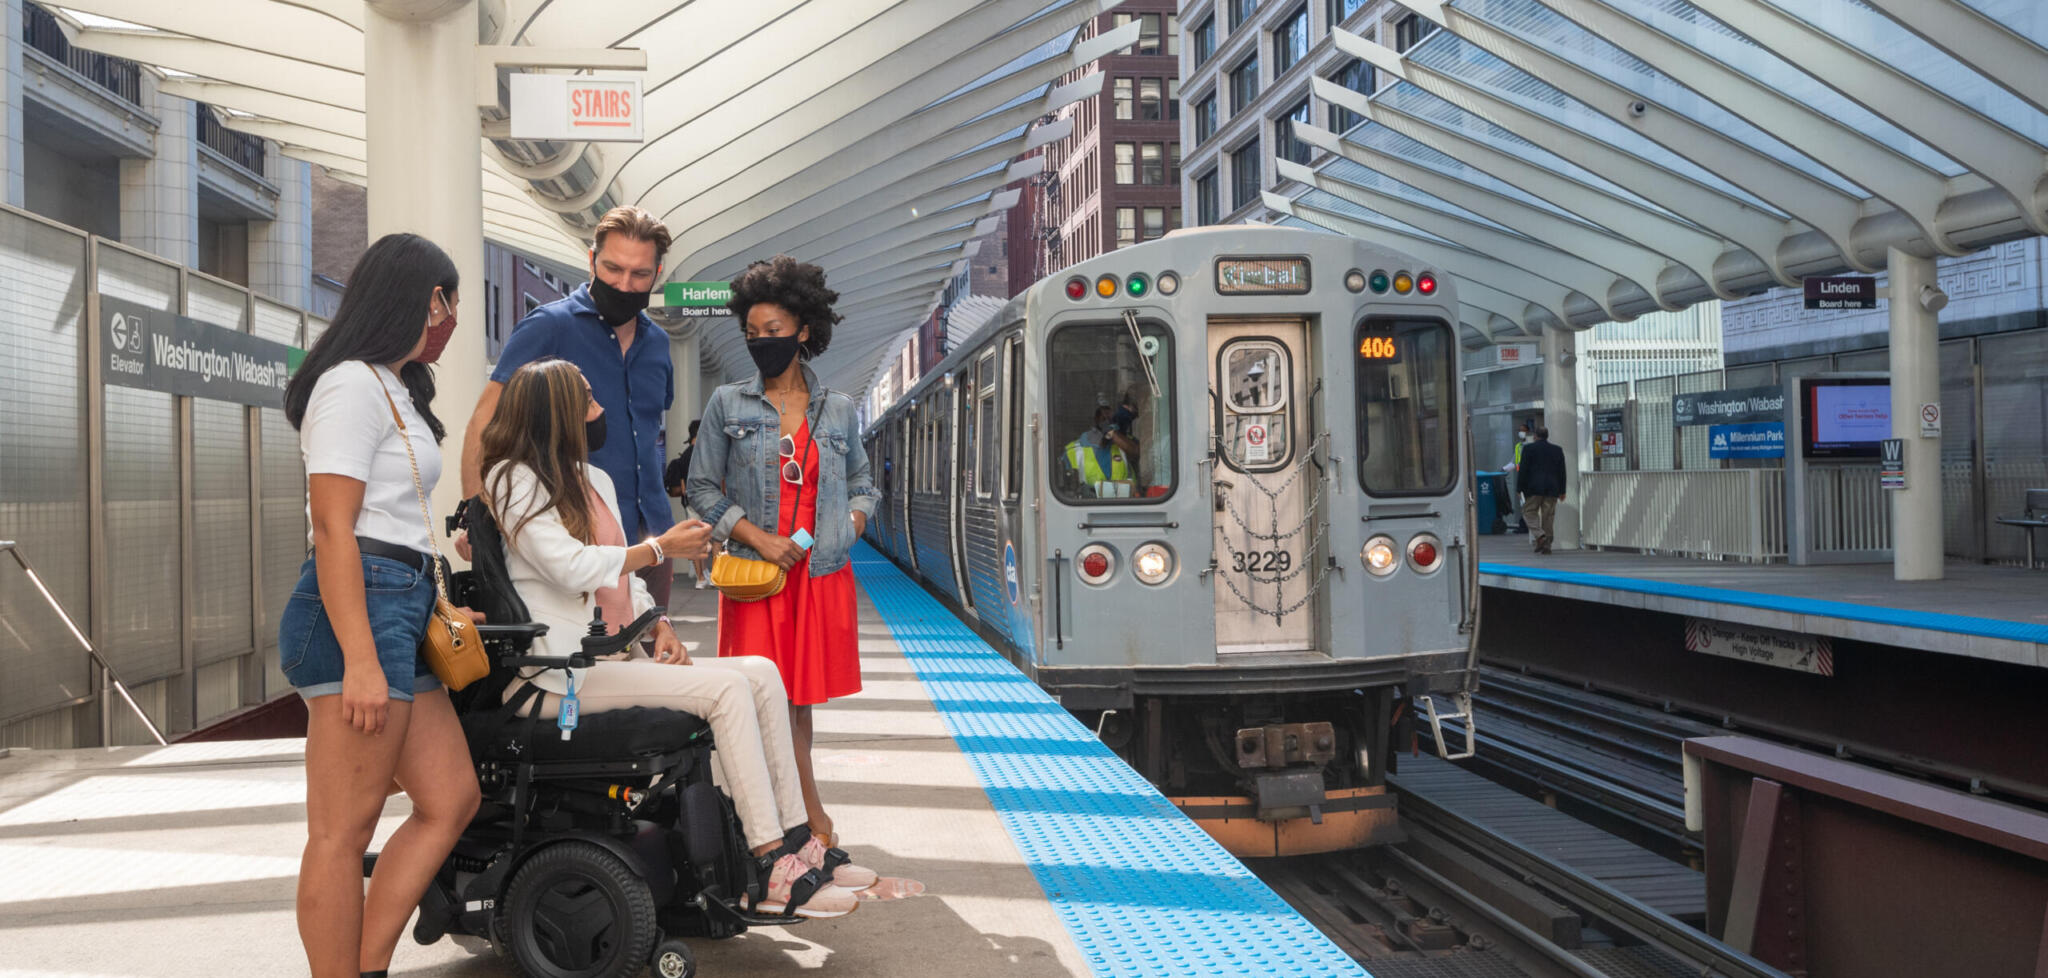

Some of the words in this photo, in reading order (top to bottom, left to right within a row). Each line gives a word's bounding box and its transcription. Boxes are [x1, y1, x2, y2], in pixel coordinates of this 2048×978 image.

[572, 89, 631, 118] STAIRS
[682, 288, 731, 300] Harlem
[1820, 282, 1860, 294] Linden
[682, 307, 709, 316] Board
[711, 307, 732, 316] here
[1819, 300, 1842, 308] Board
[1844, 300, 1862, 308] here
[1361, 337, 1395, 358] 406
[110, 353, 144, 375] Elevator
[152, 333, 275, 387] Washington/Wabash
[1730, 431, 1765, 443] Millennium
[1766, 430, 1783, 441] Park
[1884, 441, 1900, 461] W
[1232, 550, 1291, 573] 3229
[1732, 643, 1748, 656] High
[1748, 646, 1774, 661] Voltage
[483, 899, 495, 910] F3
